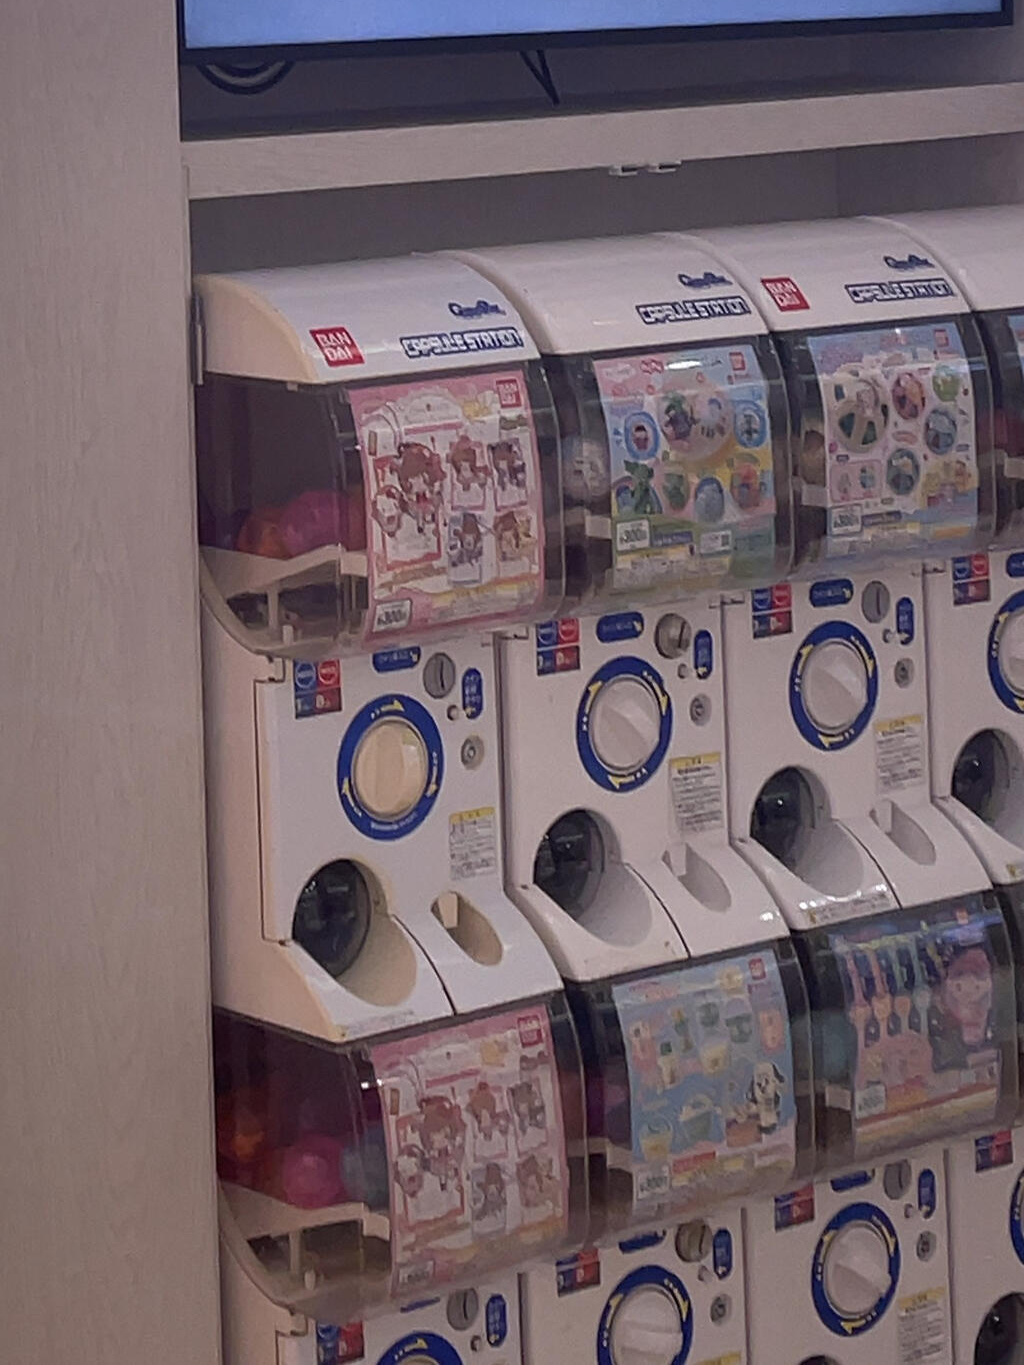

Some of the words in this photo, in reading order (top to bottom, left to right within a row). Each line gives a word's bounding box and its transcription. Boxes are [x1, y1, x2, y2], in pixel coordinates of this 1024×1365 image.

[637, 301, 697, 324] CAPSULE
[695, 296, 750, 318] STATION
[315, 331, 352, 346] BAN
[401, 334, 464, 358] CAPSULE
[464, 328, 523, 351] STATION
[324, 346, 354, 362] DAI
